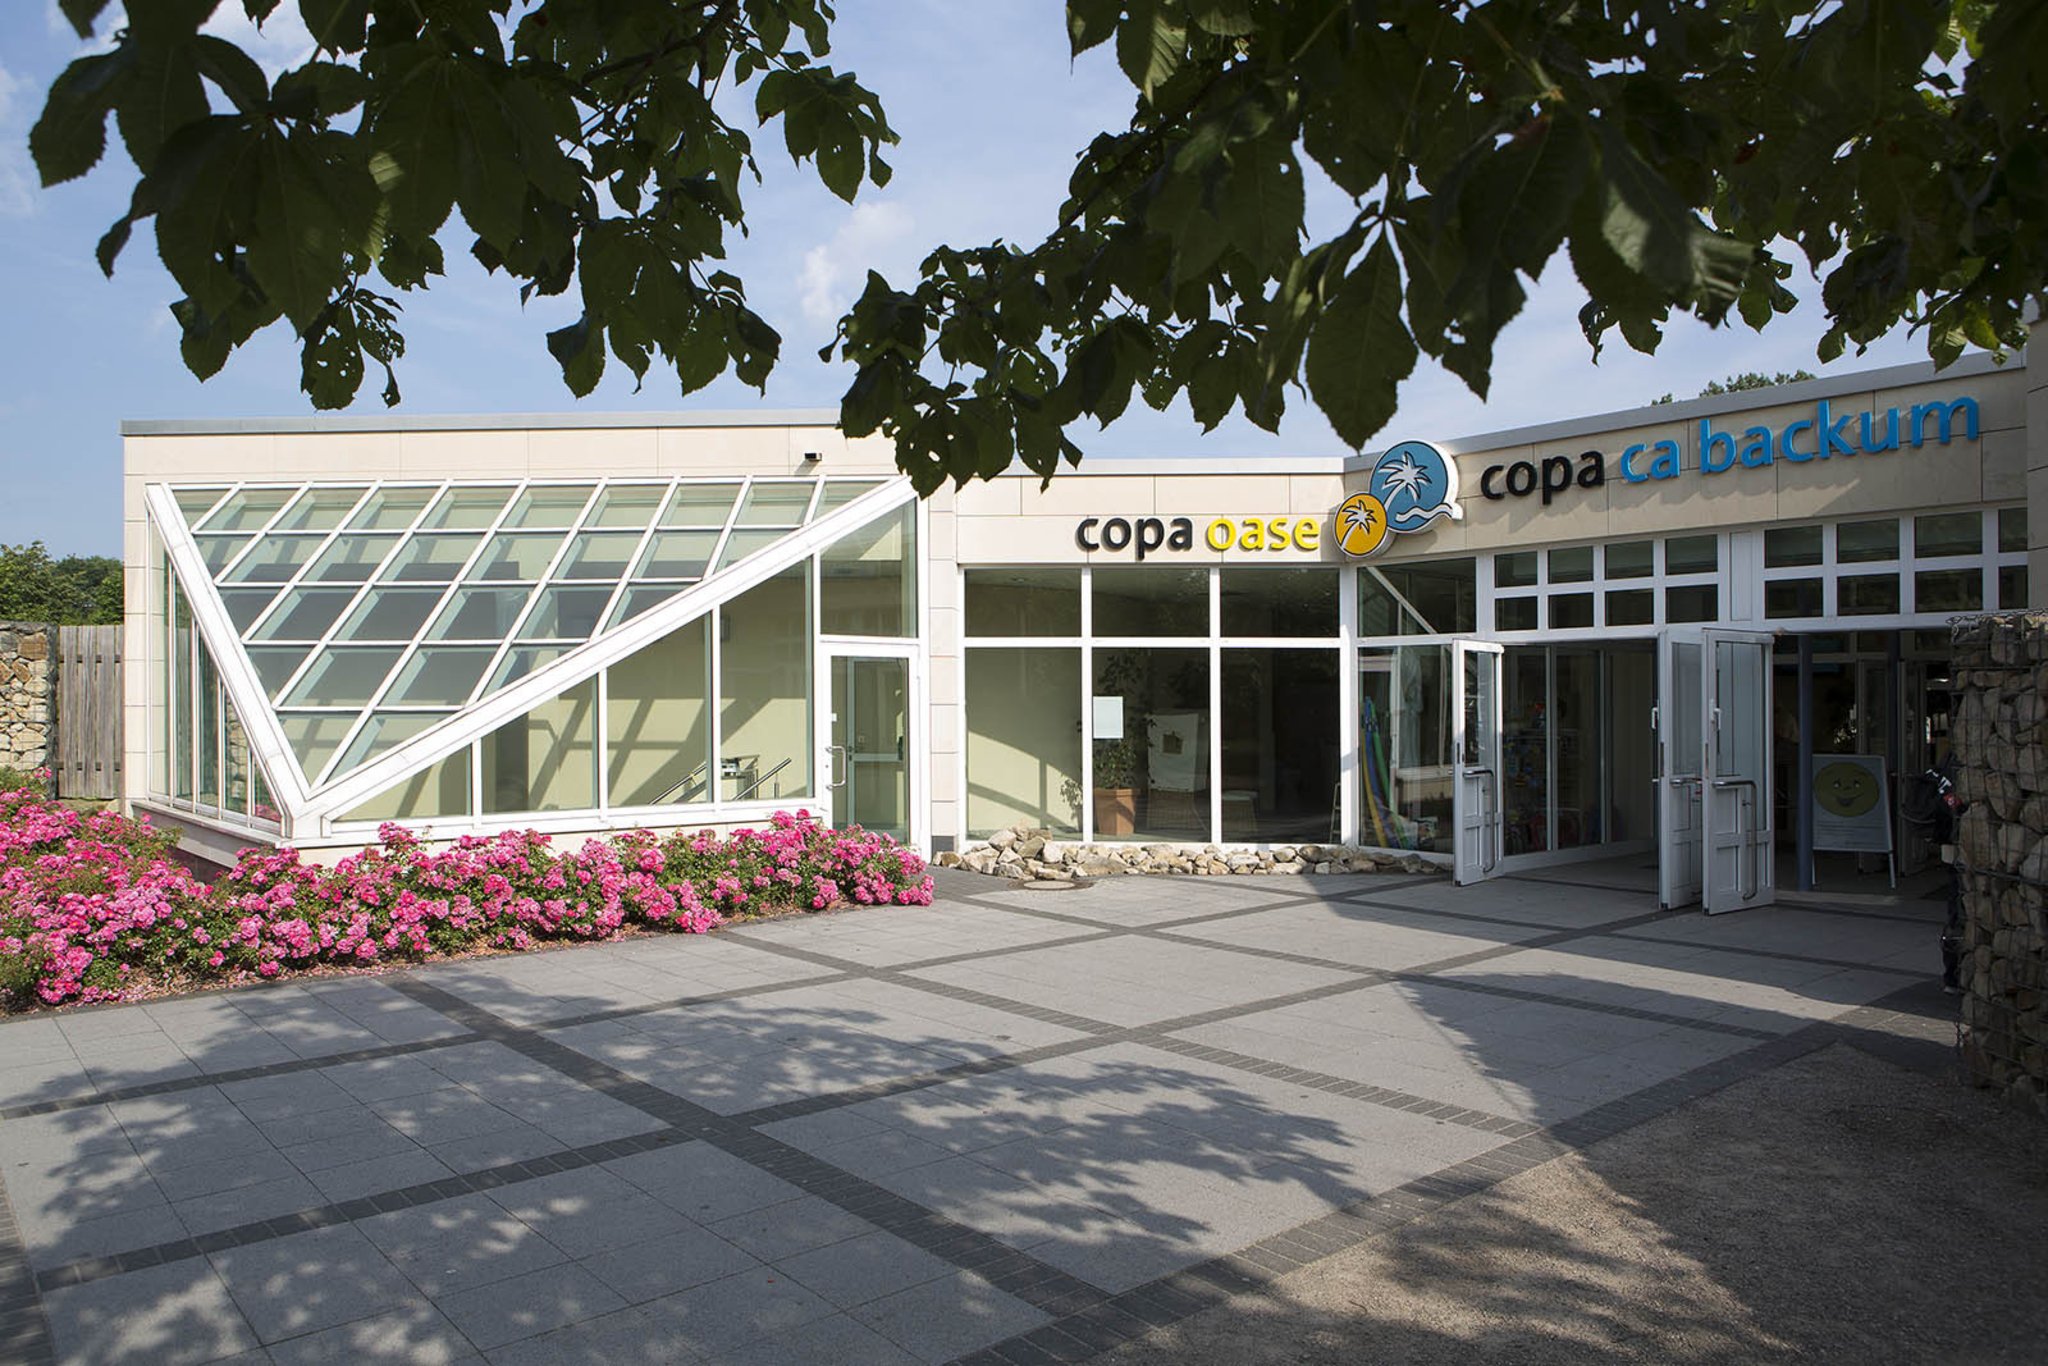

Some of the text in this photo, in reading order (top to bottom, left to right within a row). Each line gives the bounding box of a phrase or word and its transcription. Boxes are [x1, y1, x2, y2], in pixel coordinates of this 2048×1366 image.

[1481, 396, 1979, 505] copa ca backum
[1077, 517, 1320, 560] copa oase
